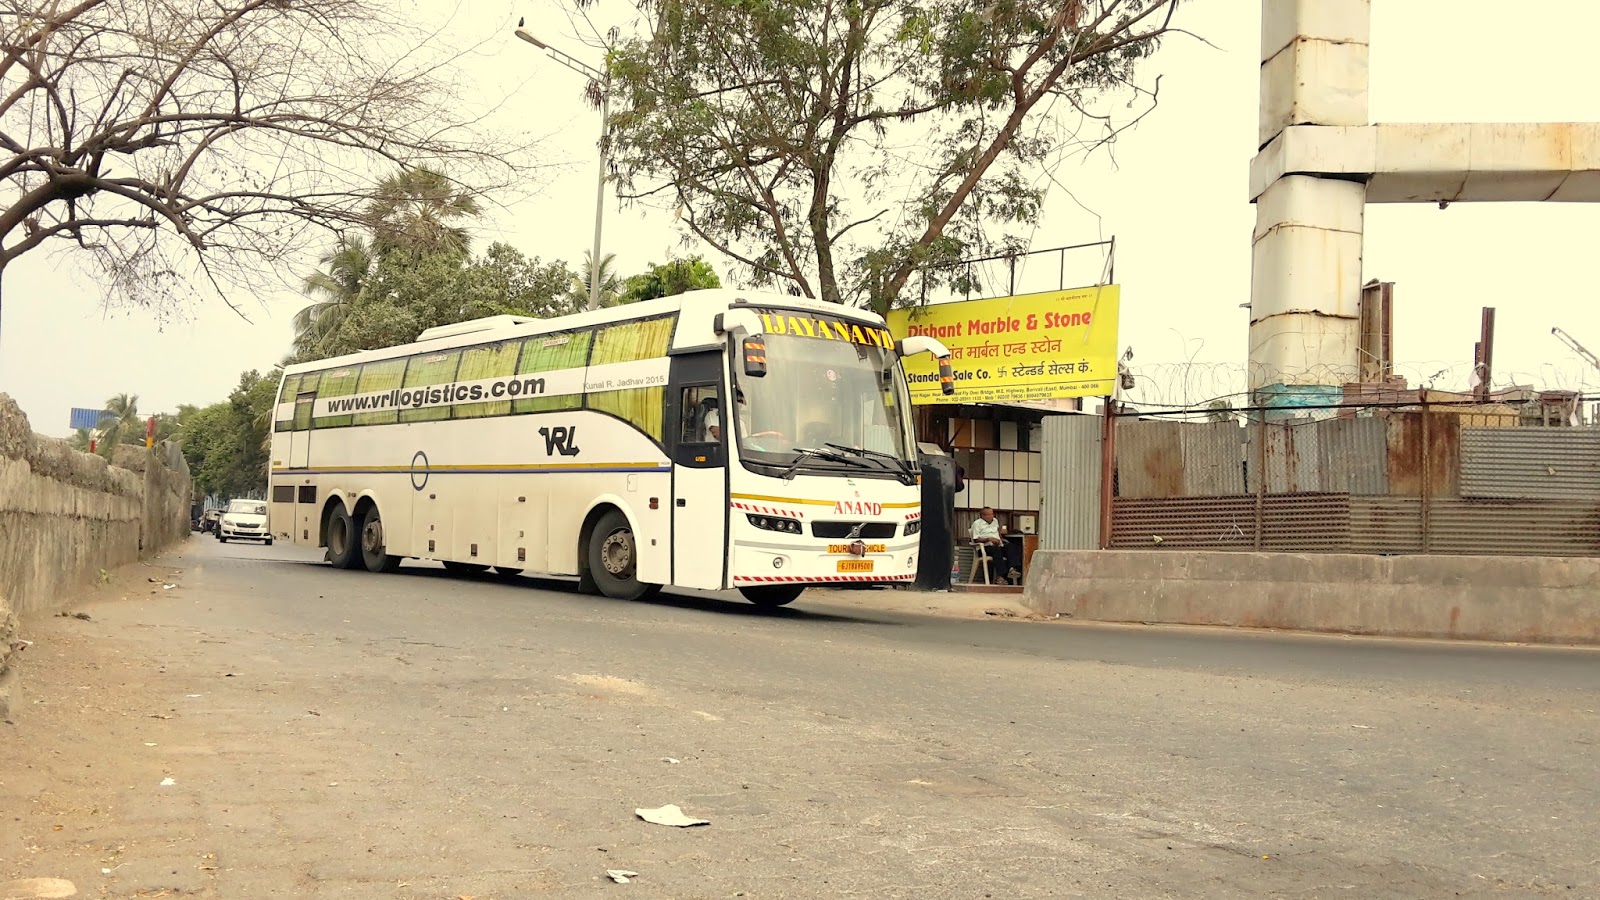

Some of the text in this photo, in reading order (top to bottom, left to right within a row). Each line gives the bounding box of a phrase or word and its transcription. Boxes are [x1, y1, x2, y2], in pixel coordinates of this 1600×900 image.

[756, 313, 896, 350] IJAYANAND
[968, 316, 1020, 336] Marble
[1026, 313, 1038, 331] &
[1044, 311, 1092, 329] Stone
[1031, 335, 1062, 353] स्टोन
[908, 369, 991, 383] Standa Sale Co.
[328, 377, 546, 413] www.vrllogistics.com
[538, 426, 580, 457] VRL
[834, 501, 882, 515] ANAND
